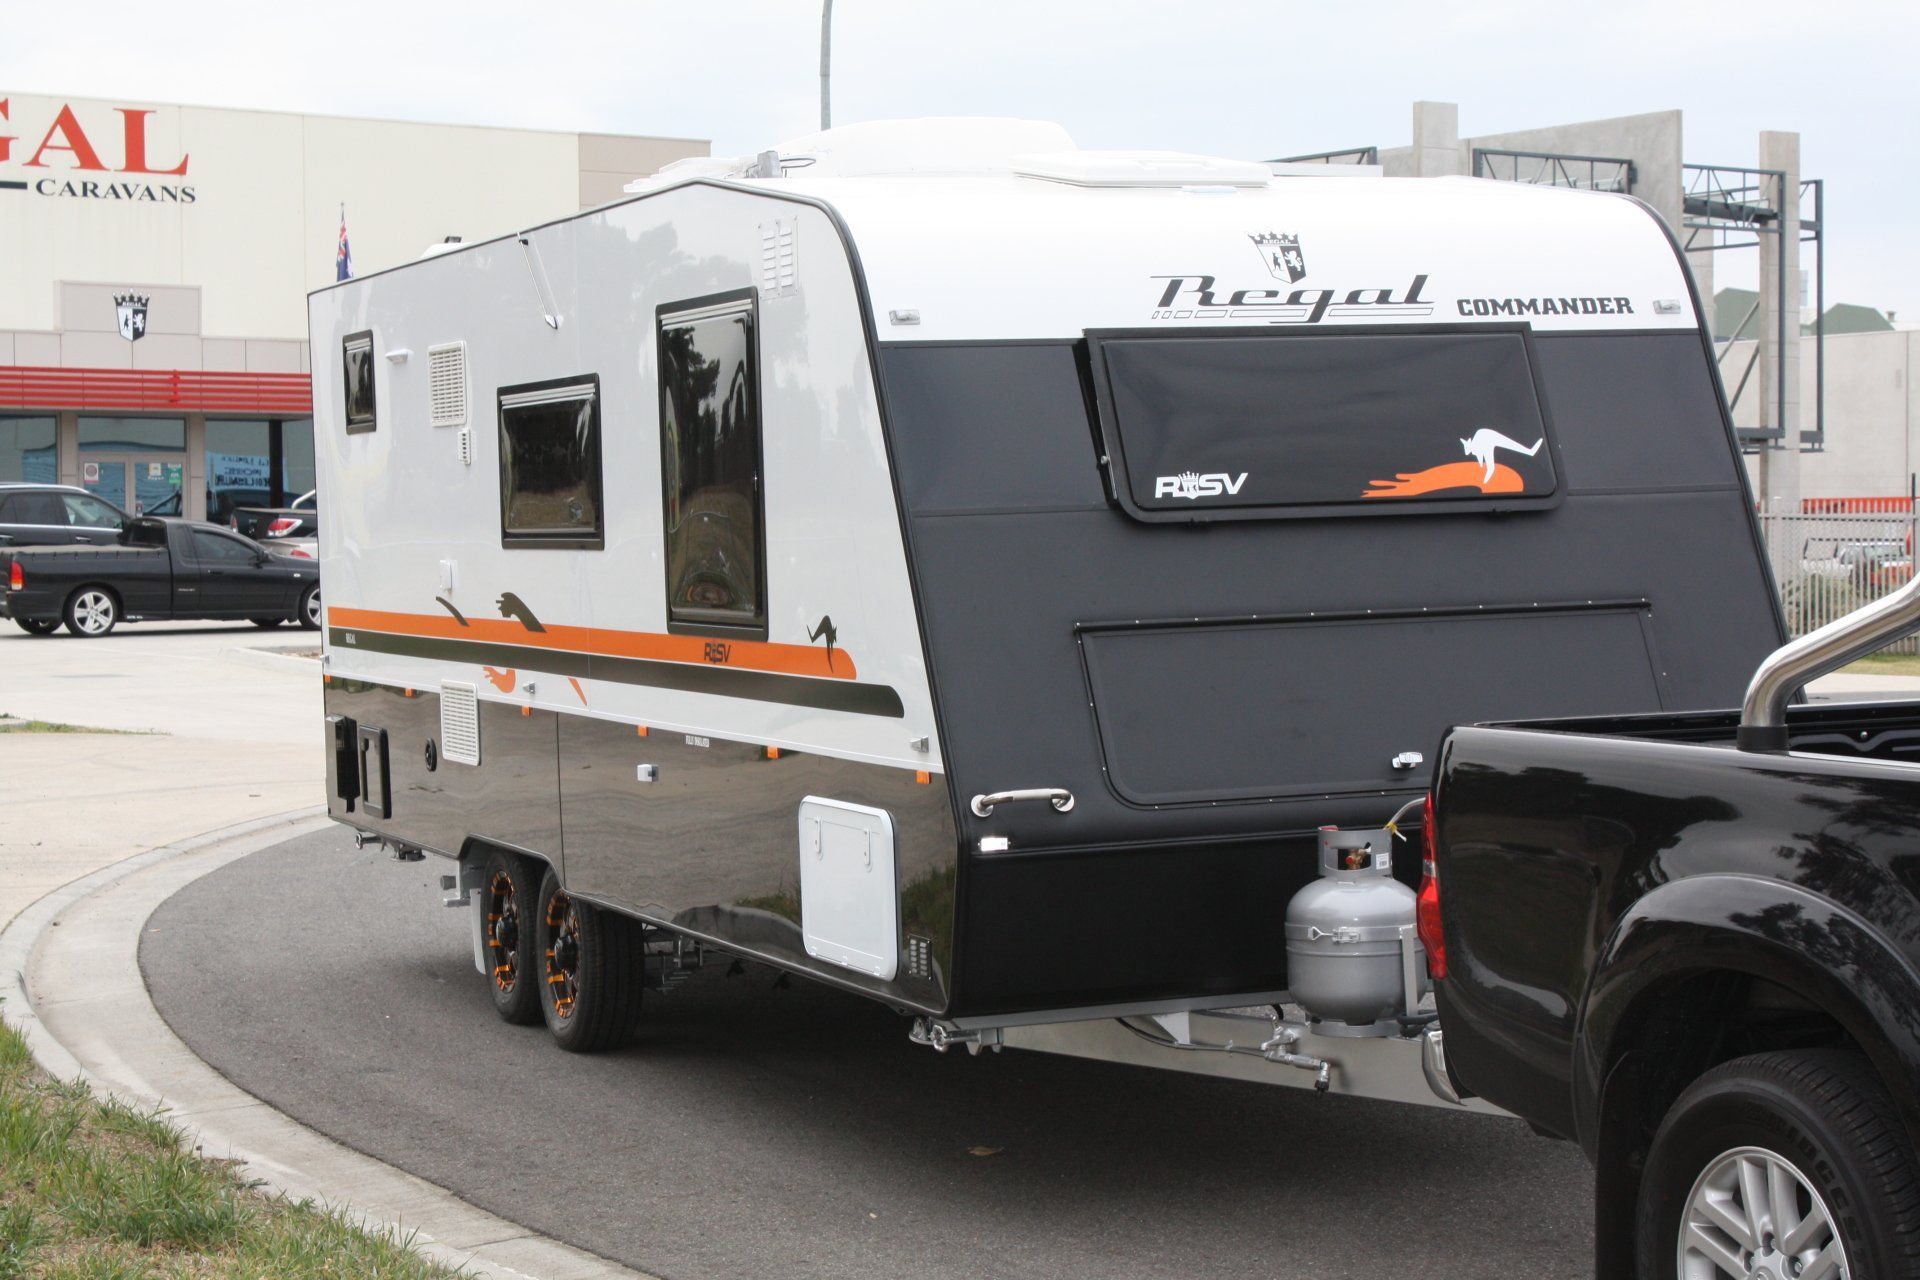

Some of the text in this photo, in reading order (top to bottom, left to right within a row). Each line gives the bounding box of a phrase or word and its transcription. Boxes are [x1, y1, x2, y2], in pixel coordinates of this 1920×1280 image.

[0, 97, 189, 176] AL
[36, 178, 196, 203] CARAVANS
[1150, 275, 1435, 323] Regal
[1457, 297, 1634, 316] COMMANDER
